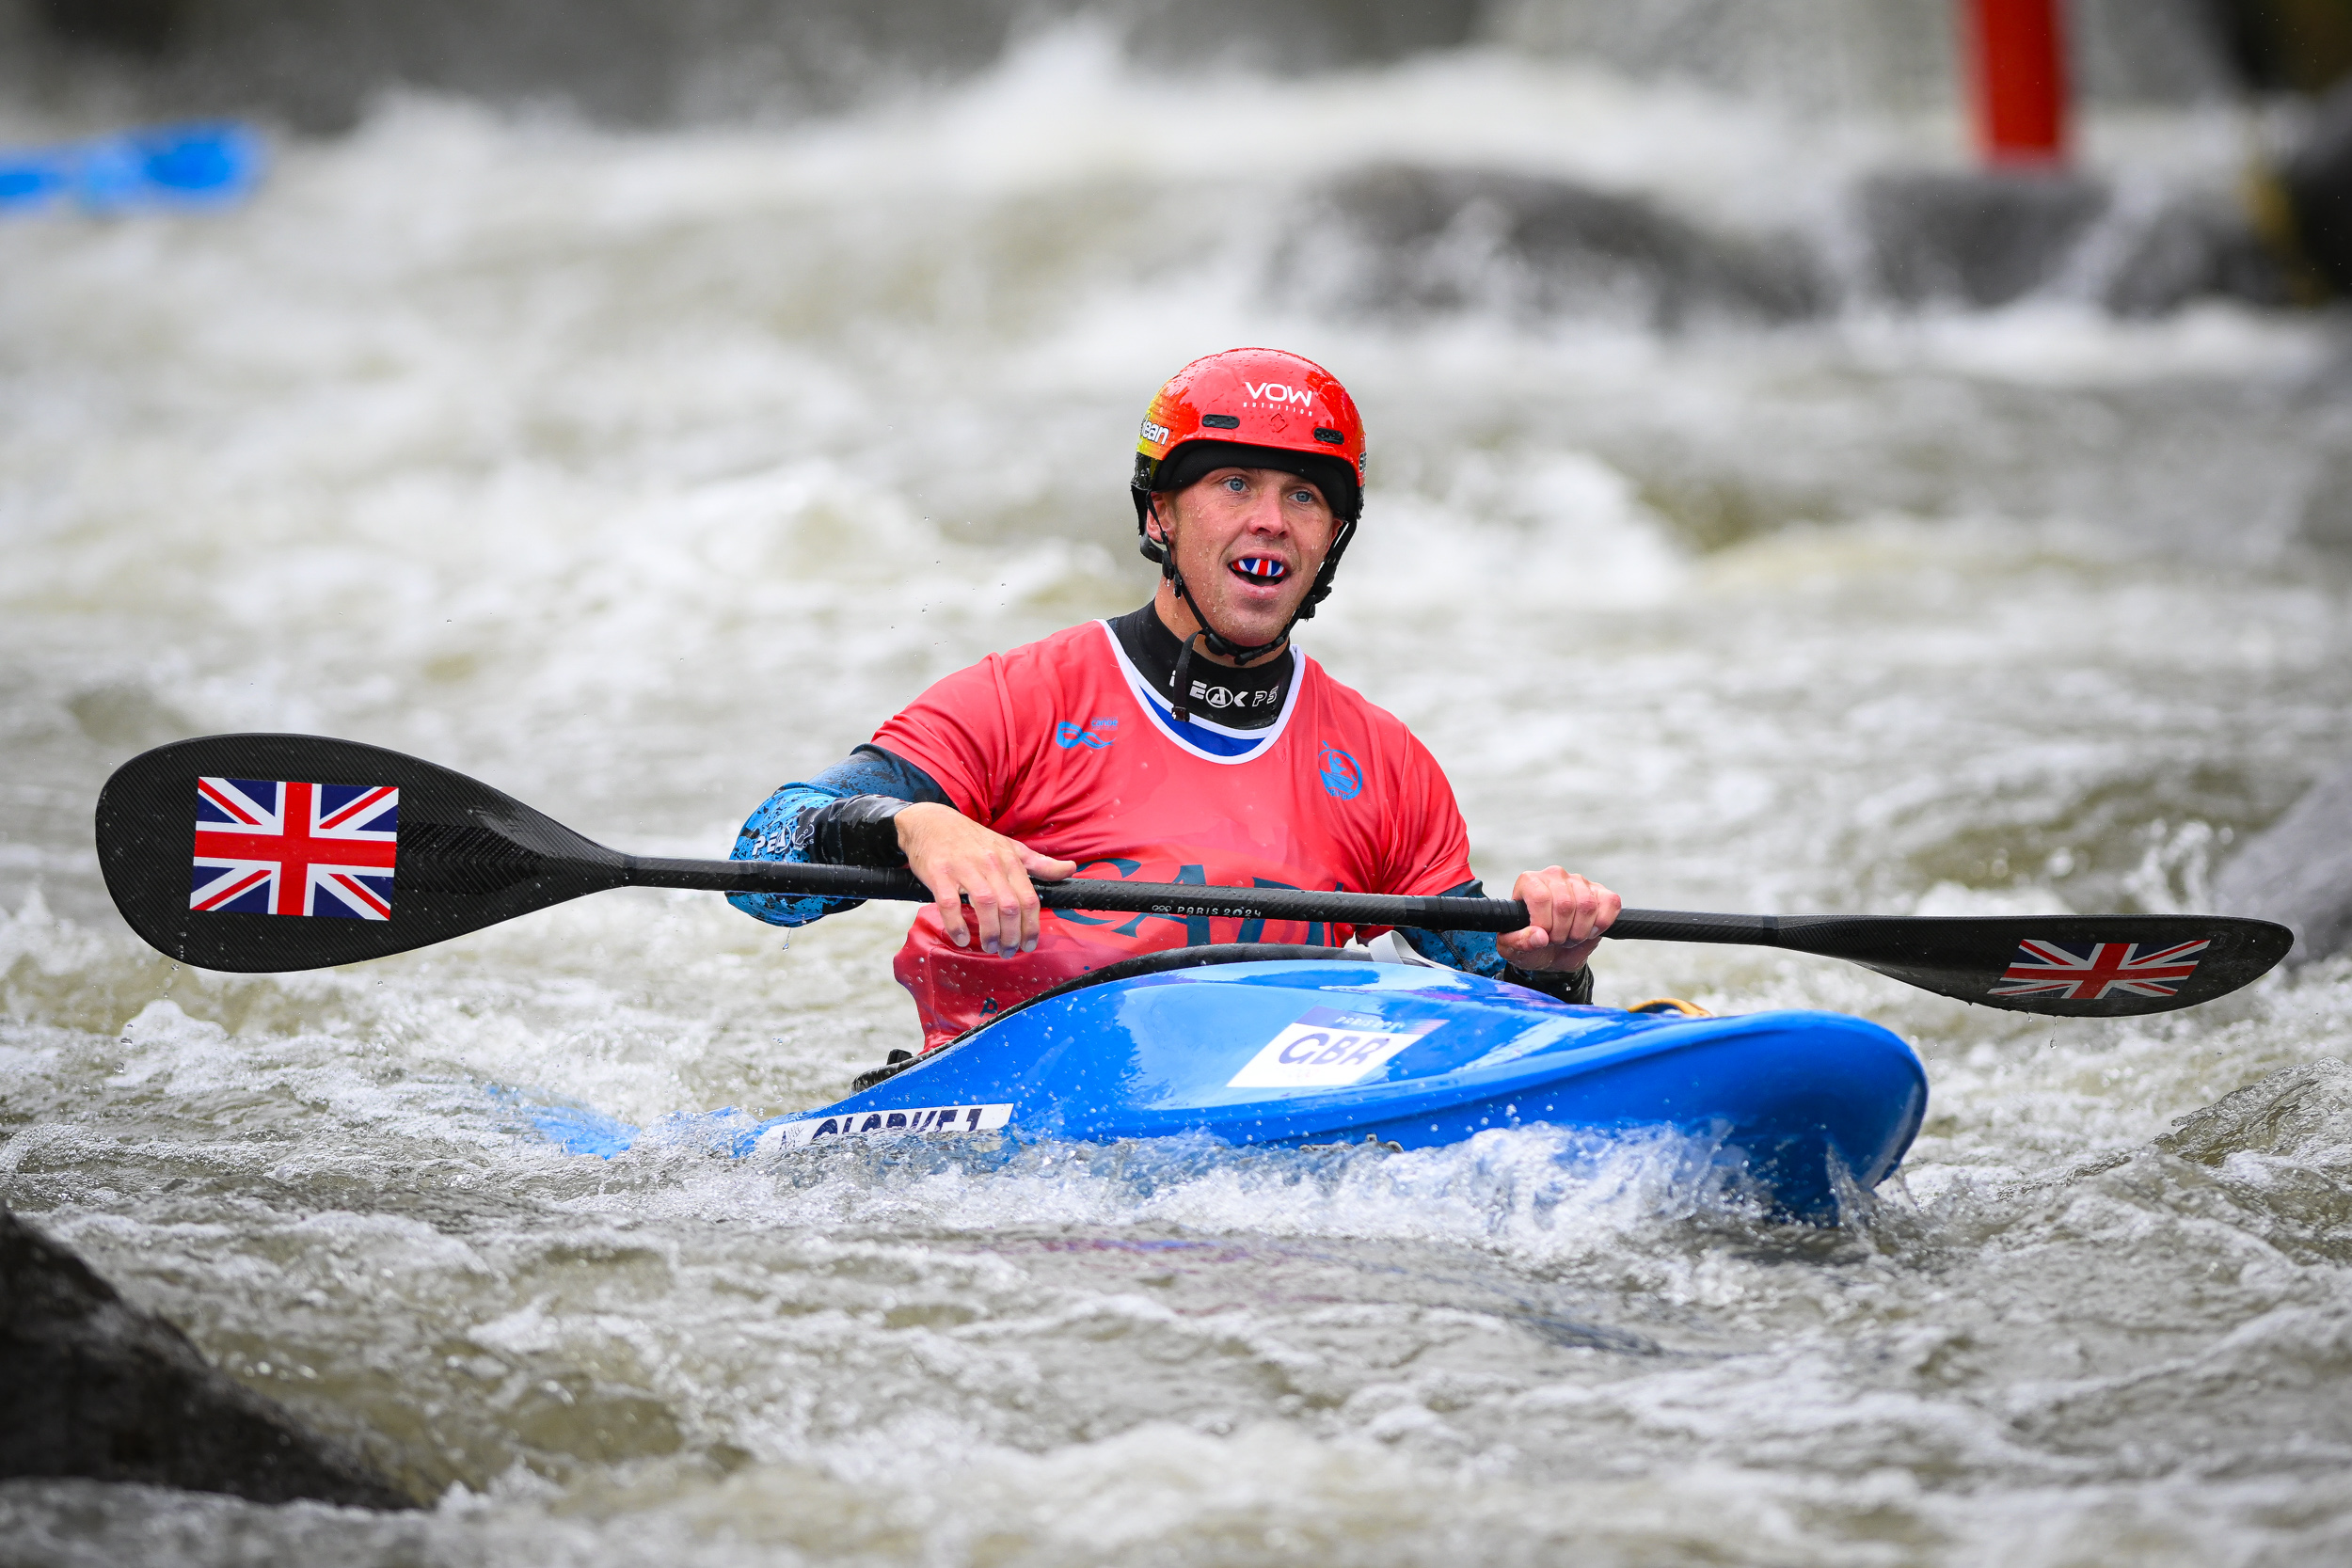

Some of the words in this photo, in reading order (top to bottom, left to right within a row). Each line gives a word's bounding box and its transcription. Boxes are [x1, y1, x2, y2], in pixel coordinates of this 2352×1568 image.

[1244, 381, 1313, 407] VOW
[1091, 719, 1118, 727] canoe
[1178, 906, 1219, 916] PARIS
[1279, 1033, 1390, 1065] GBR
